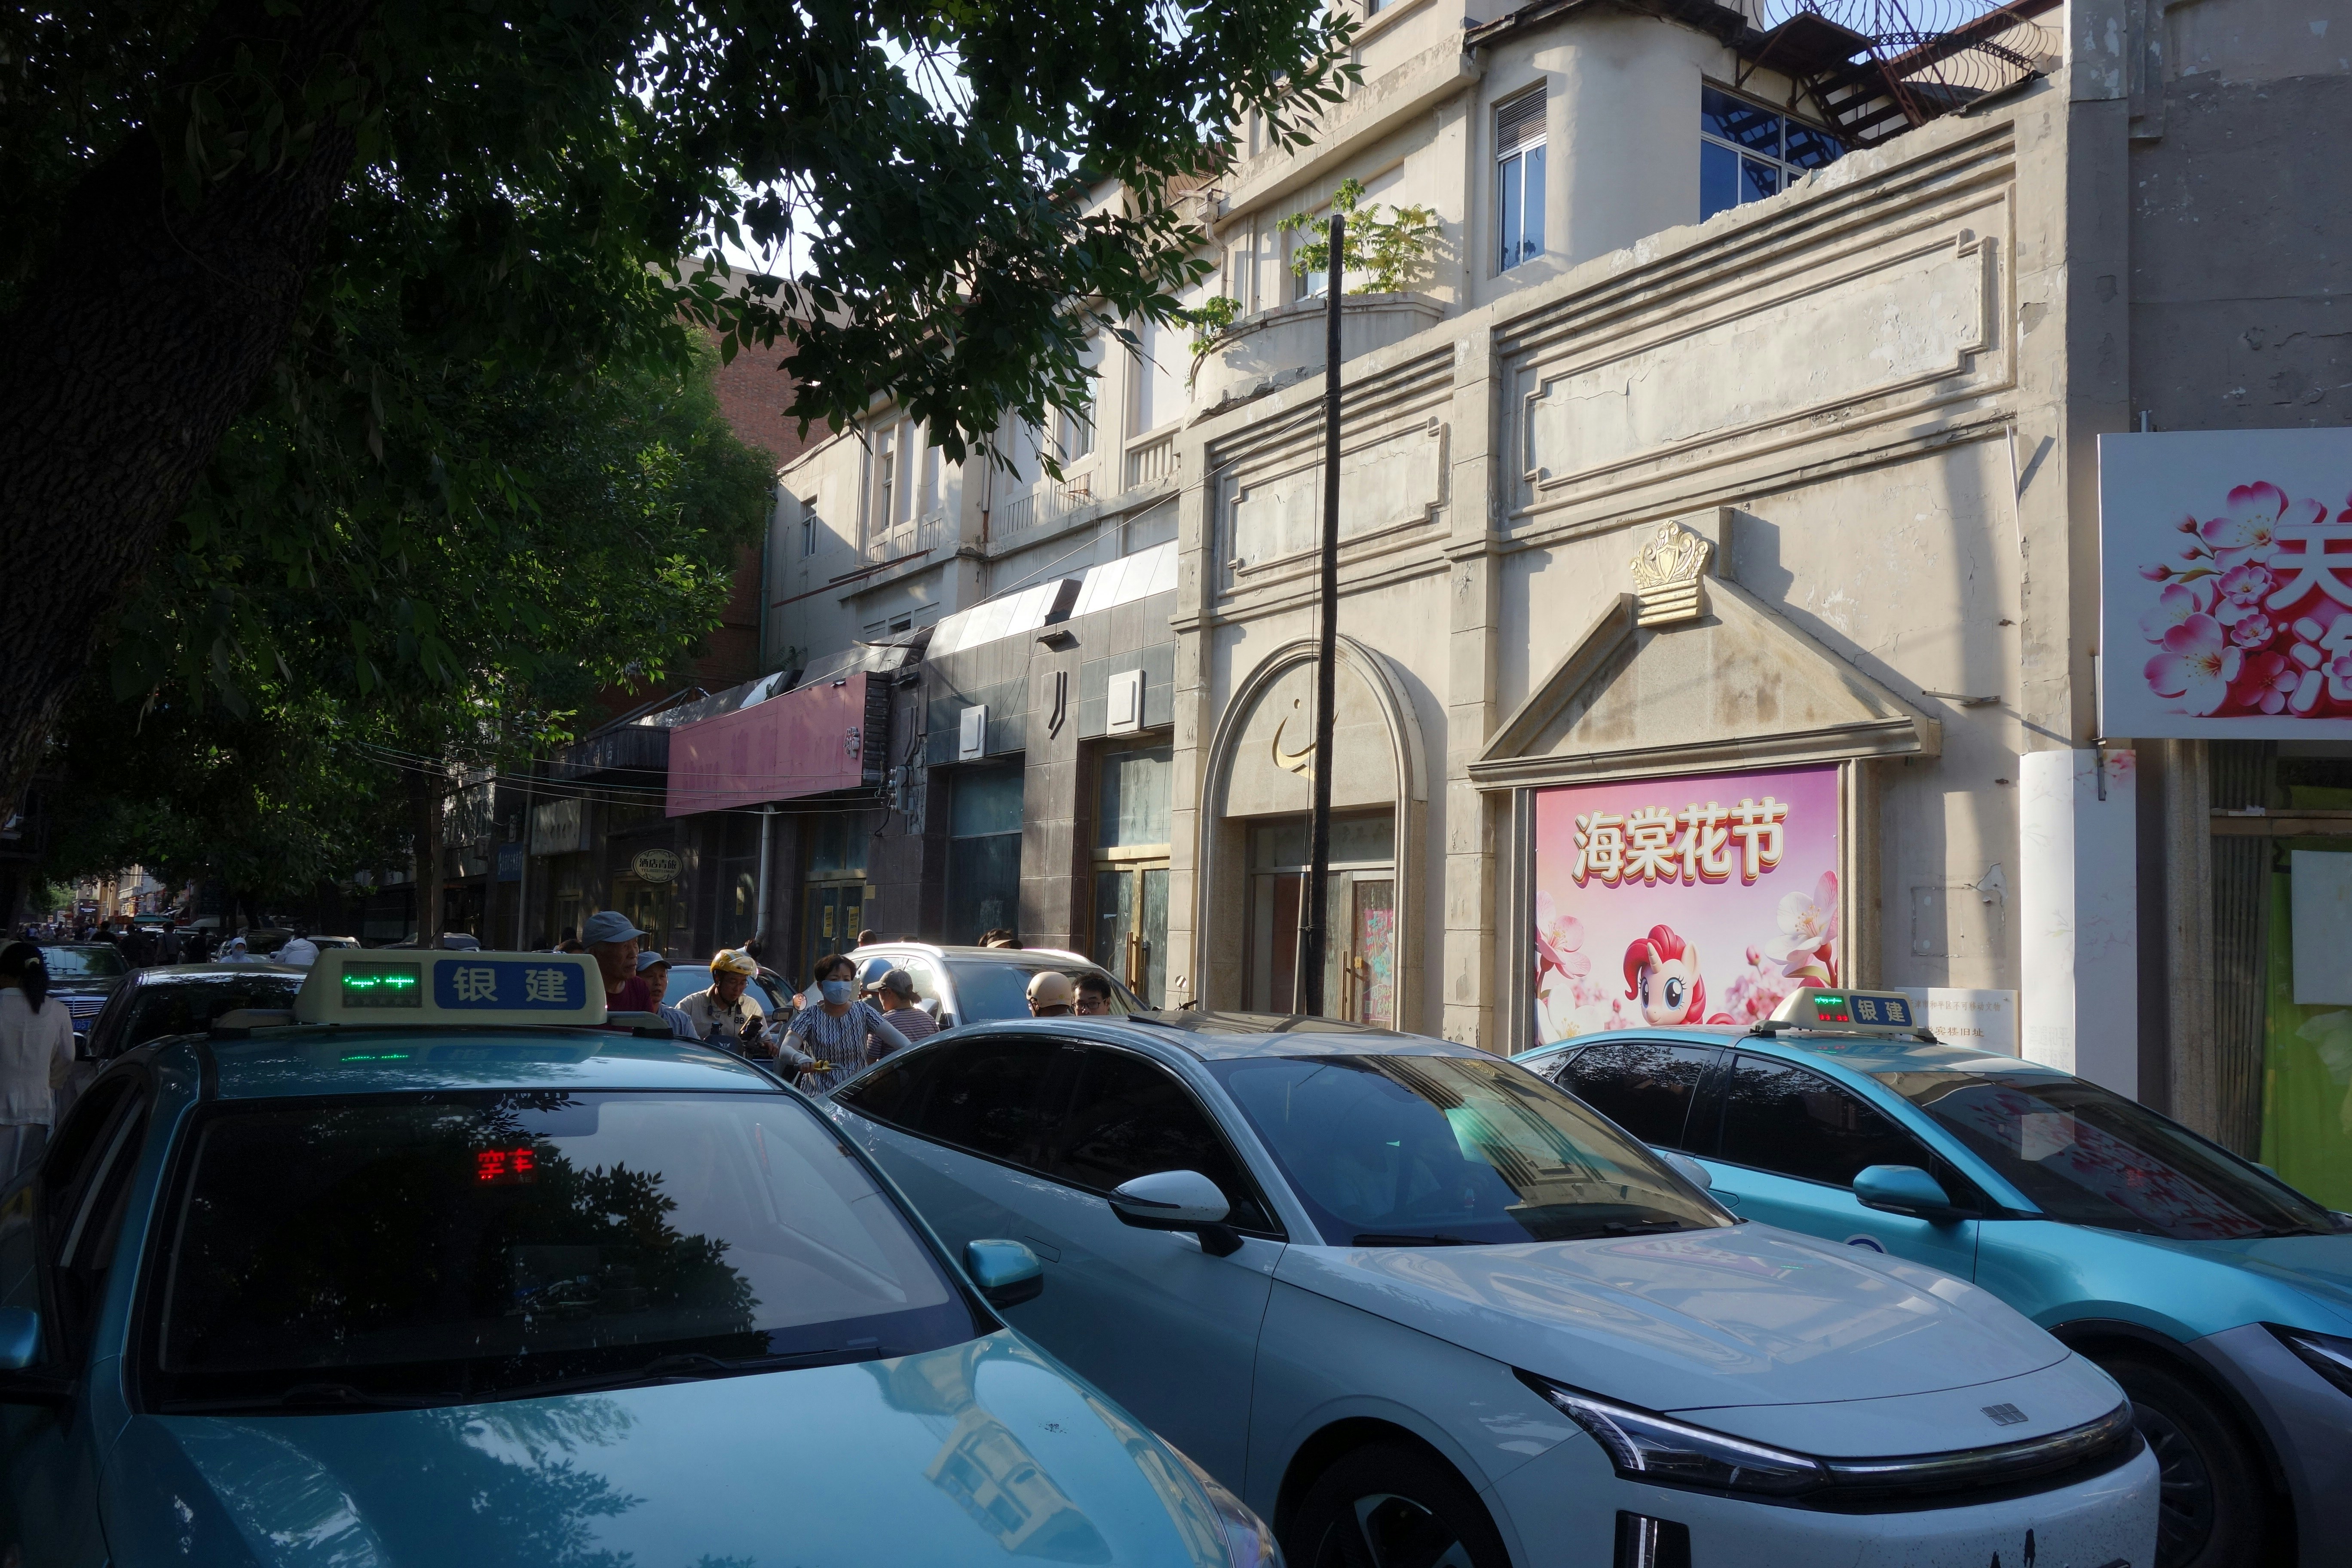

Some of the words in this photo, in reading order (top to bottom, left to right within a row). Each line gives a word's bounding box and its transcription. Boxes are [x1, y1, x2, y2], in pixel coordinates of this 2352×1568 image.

[1571, 796, 1789, 886] 海棠花节
[639, 858, 677, 869] 酒店青旅
[452, 966, 568, 1002] 银建
[1858, 998, 1906, 1023] 银建
[478, 1148, 533, 1175] 空车
